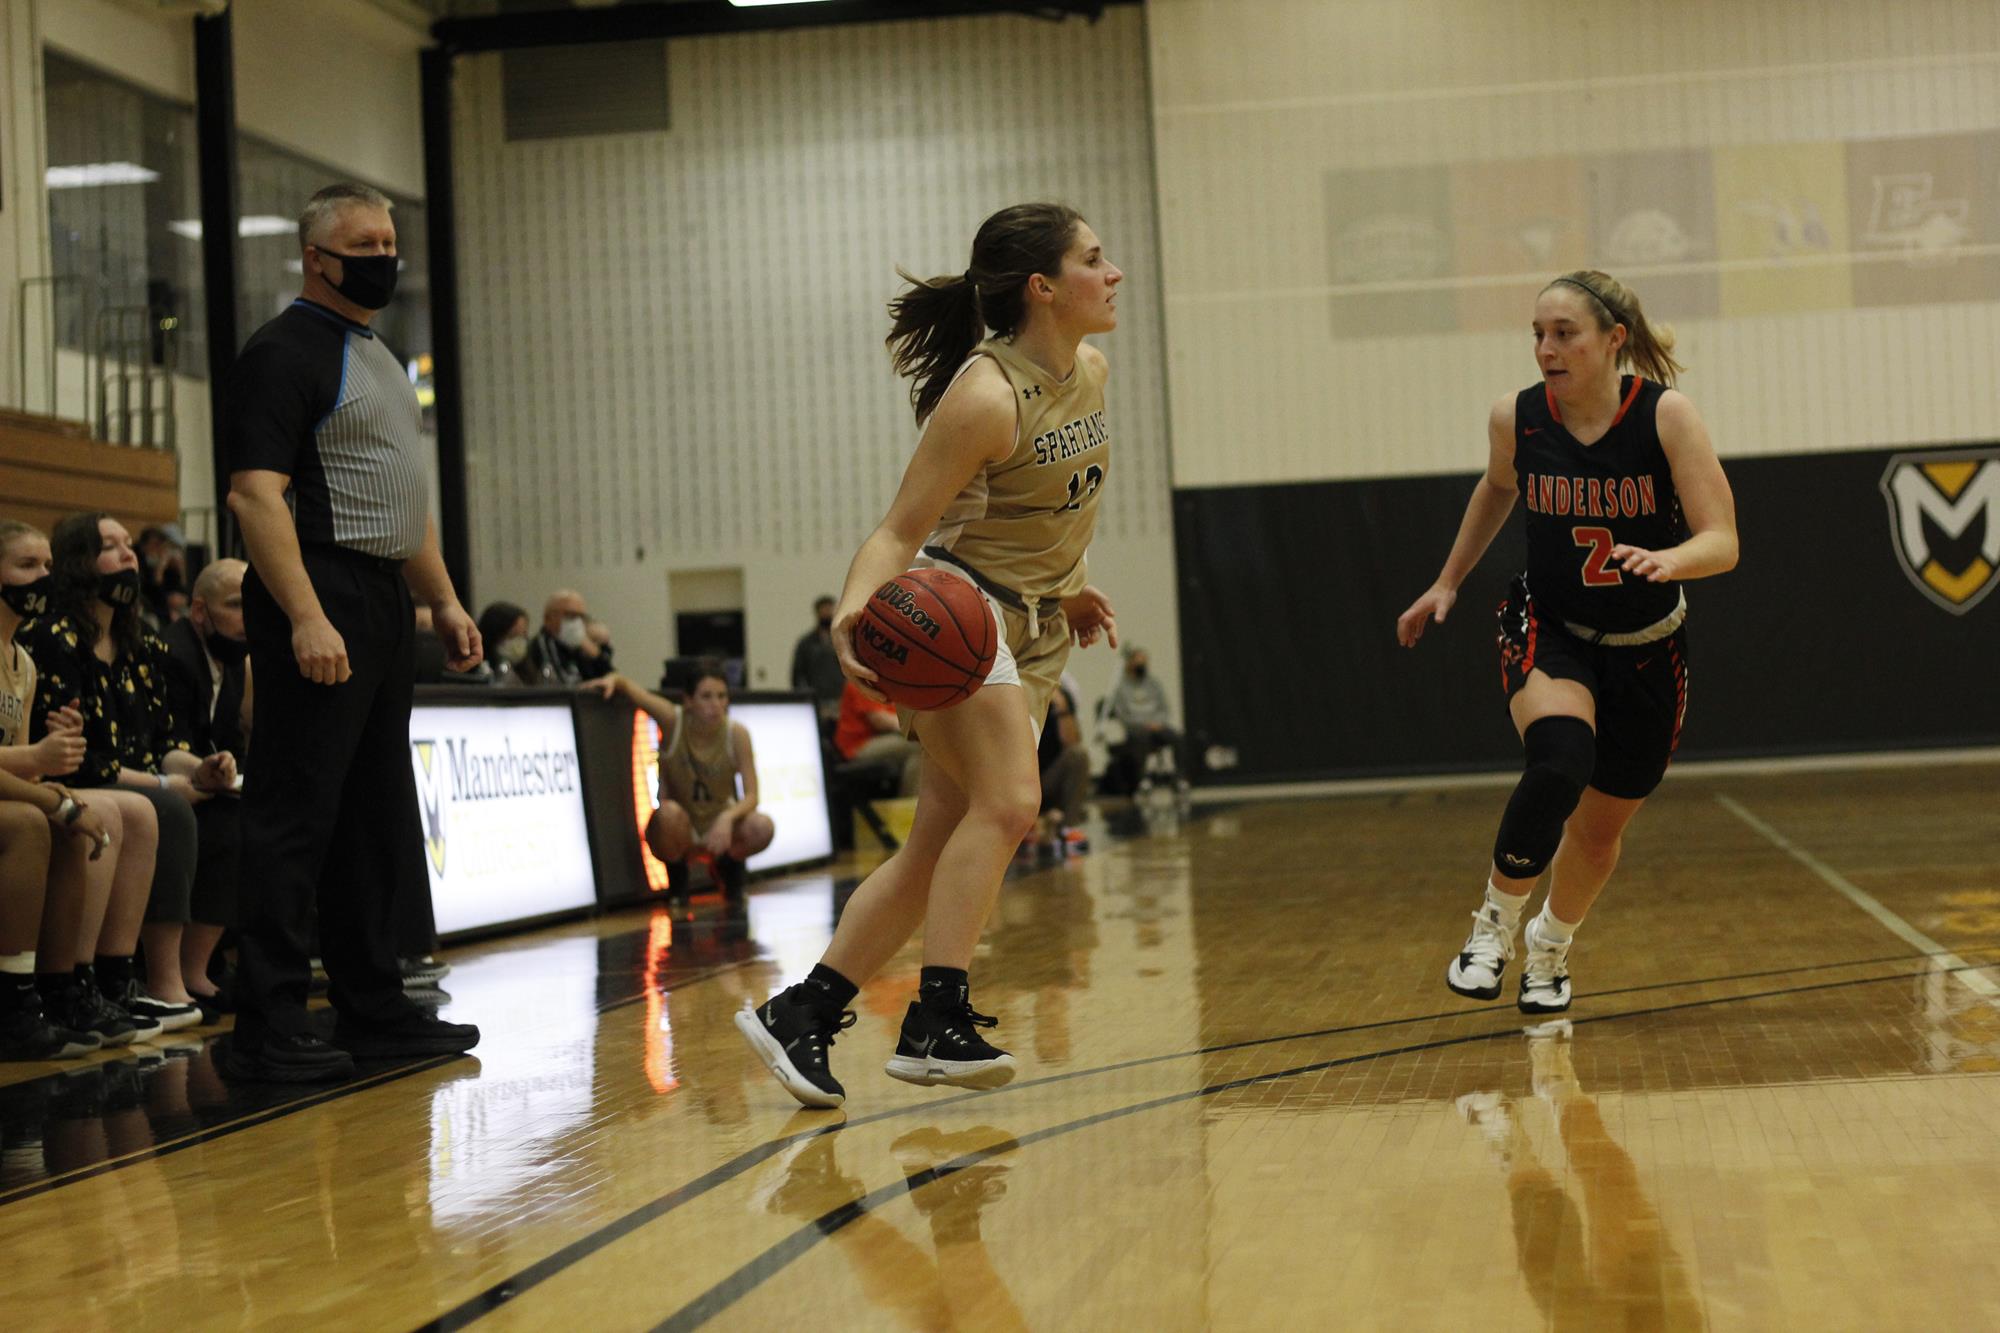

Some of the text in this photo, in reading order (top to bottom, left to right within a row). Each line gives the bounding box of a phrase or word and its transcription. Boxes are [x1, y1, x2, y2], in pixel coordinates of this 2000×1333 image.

[1527, 473, 1656, 518] ANDERSON
[1572, 526, 1623, 587] 2
[24, 592, 48, 614] 34
[875, 581, 941, 640] Wilson
[861, 621, 910, 666] NCAA
[446, 735, 576, 801] Manchester
